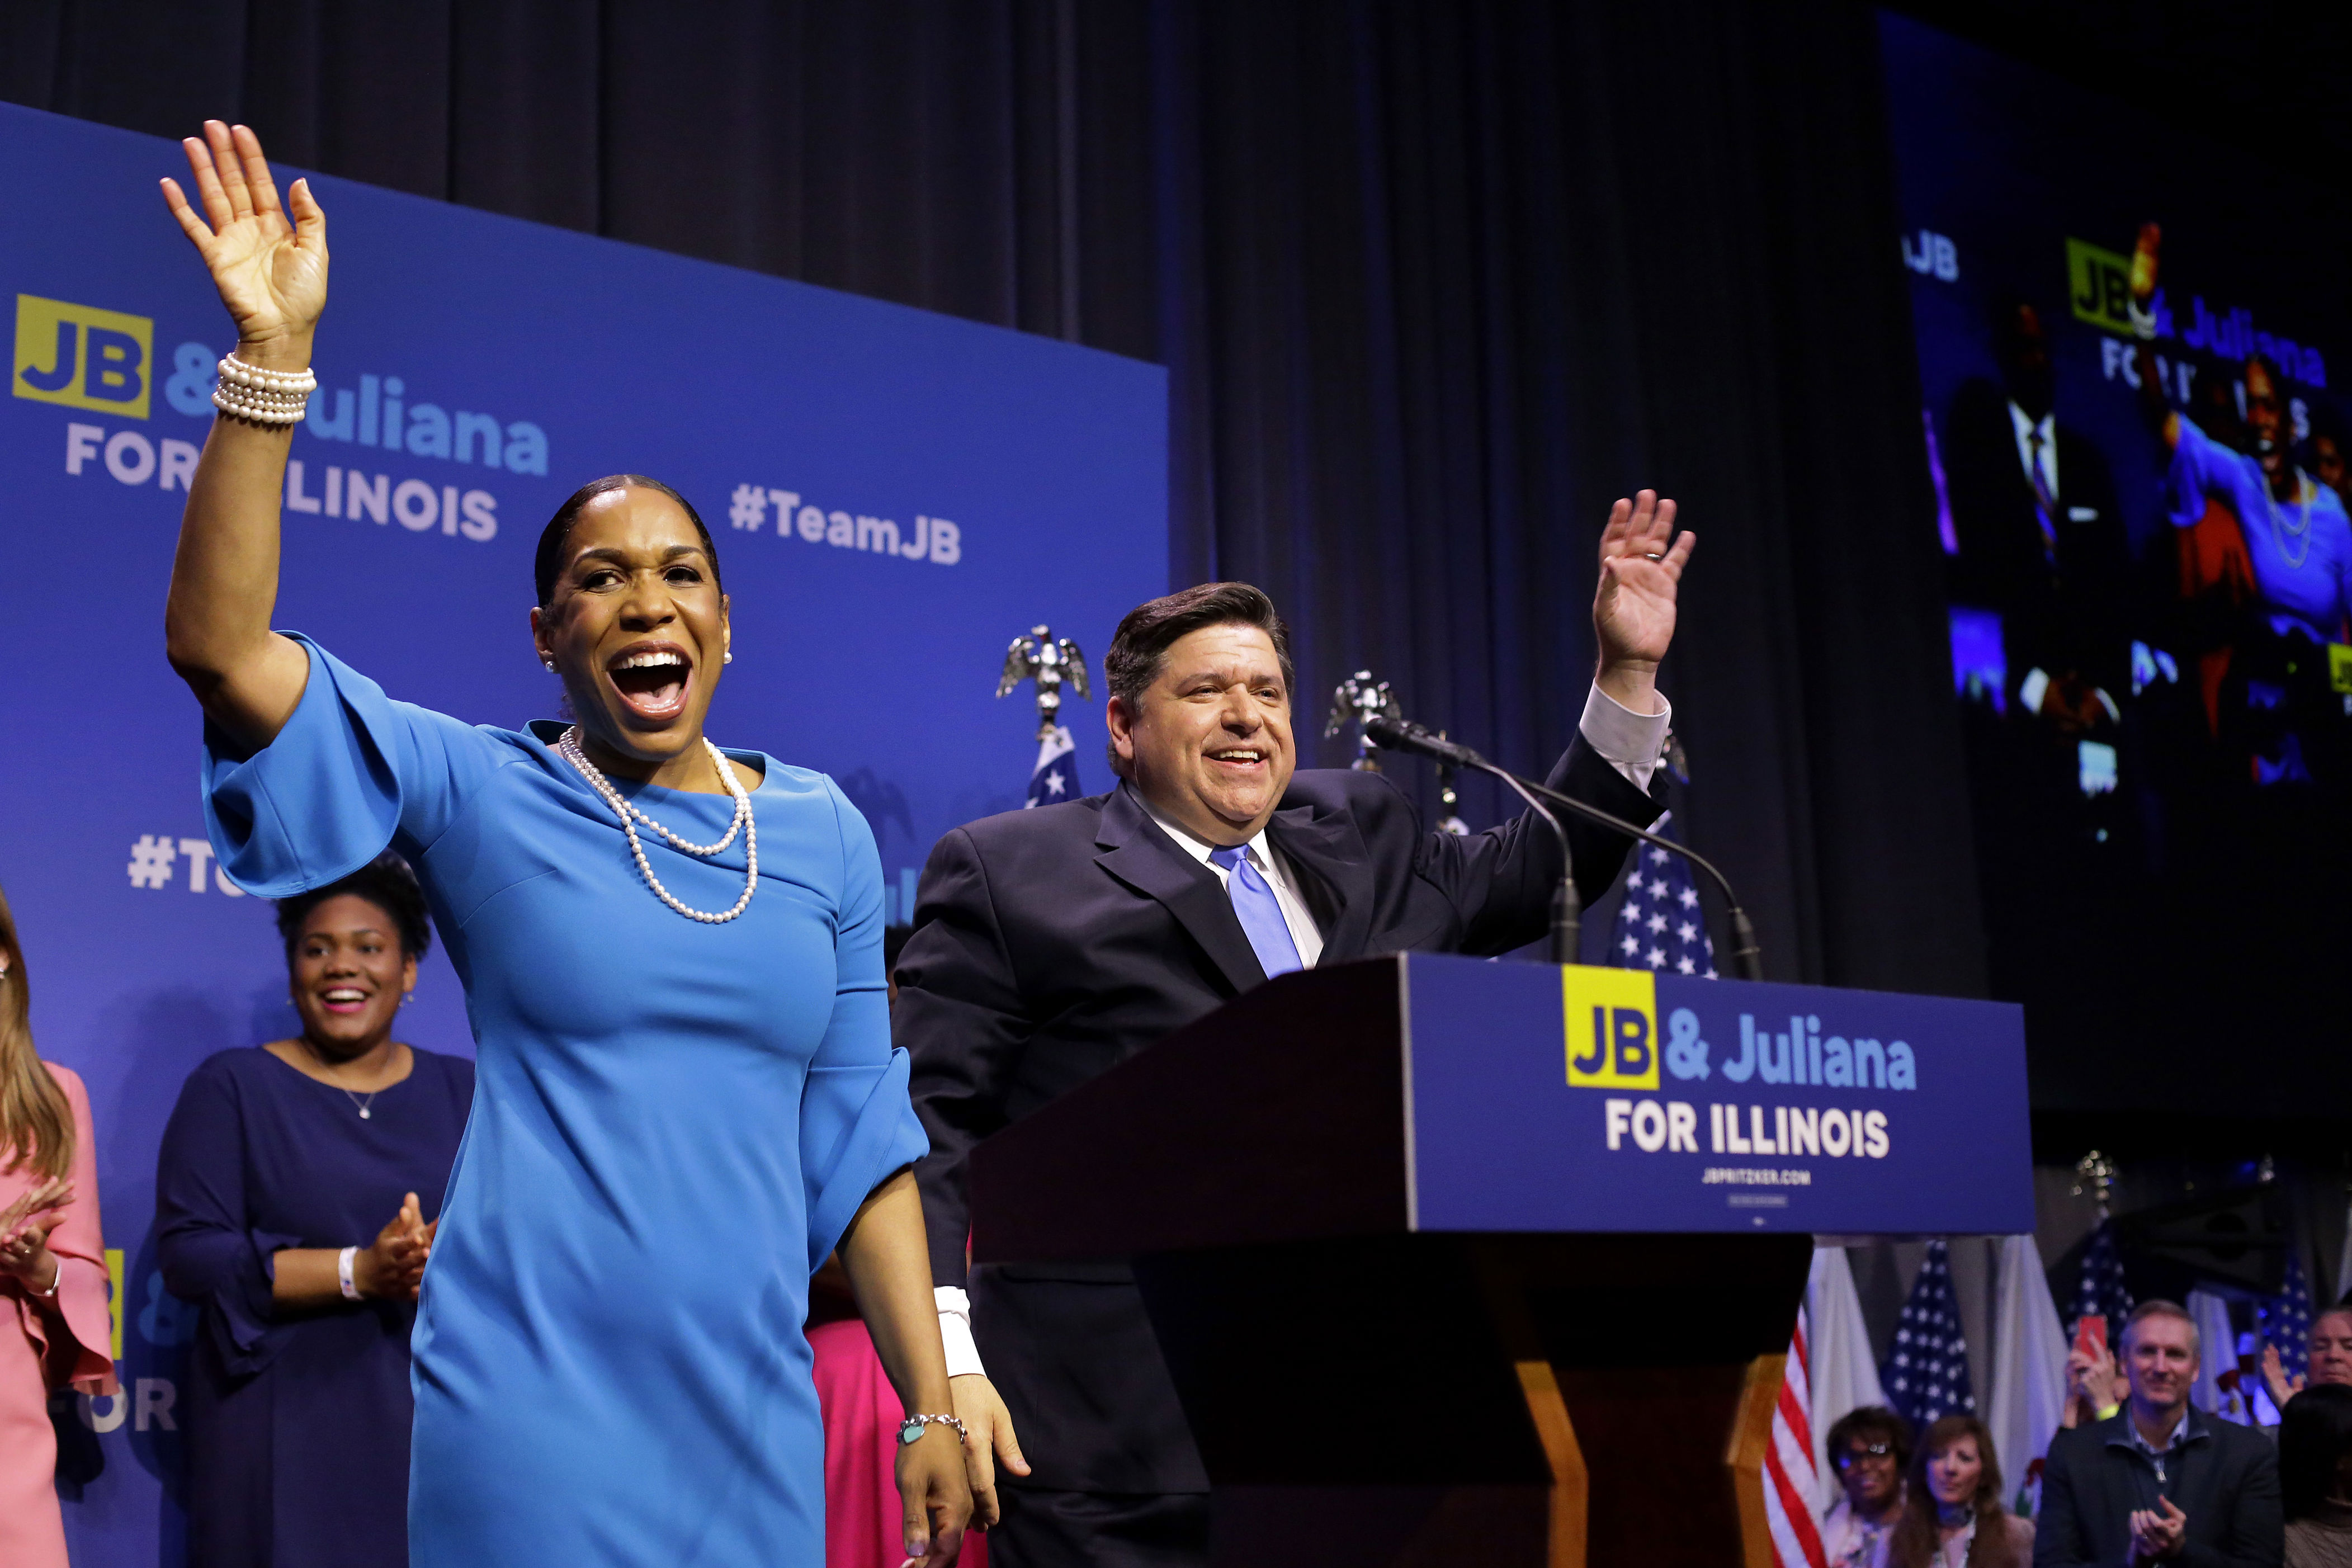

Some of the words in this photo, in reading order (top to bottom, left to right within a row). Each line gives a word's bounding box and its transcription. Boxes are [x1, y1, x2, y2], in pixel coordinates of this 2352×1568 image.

[20, 319, 143, 403] JB
[165, 341, 220, 417] &
[305, 373, 549, 476] uliana
[66, 422, 200, 493] FOR
[286, 460, 498, 542] LINOIS
[729, 484, 961, 566] #TeamJB
[1572, 1005, 1652, 1076] JB
[1665, 1008, 1710, 1081] &
[1722, 1014, 1917, 1090] Juliana
[1605, 1099, 1698, 1153] FOR
[1709, 1104, 1890, 1159] ILLINOIS
